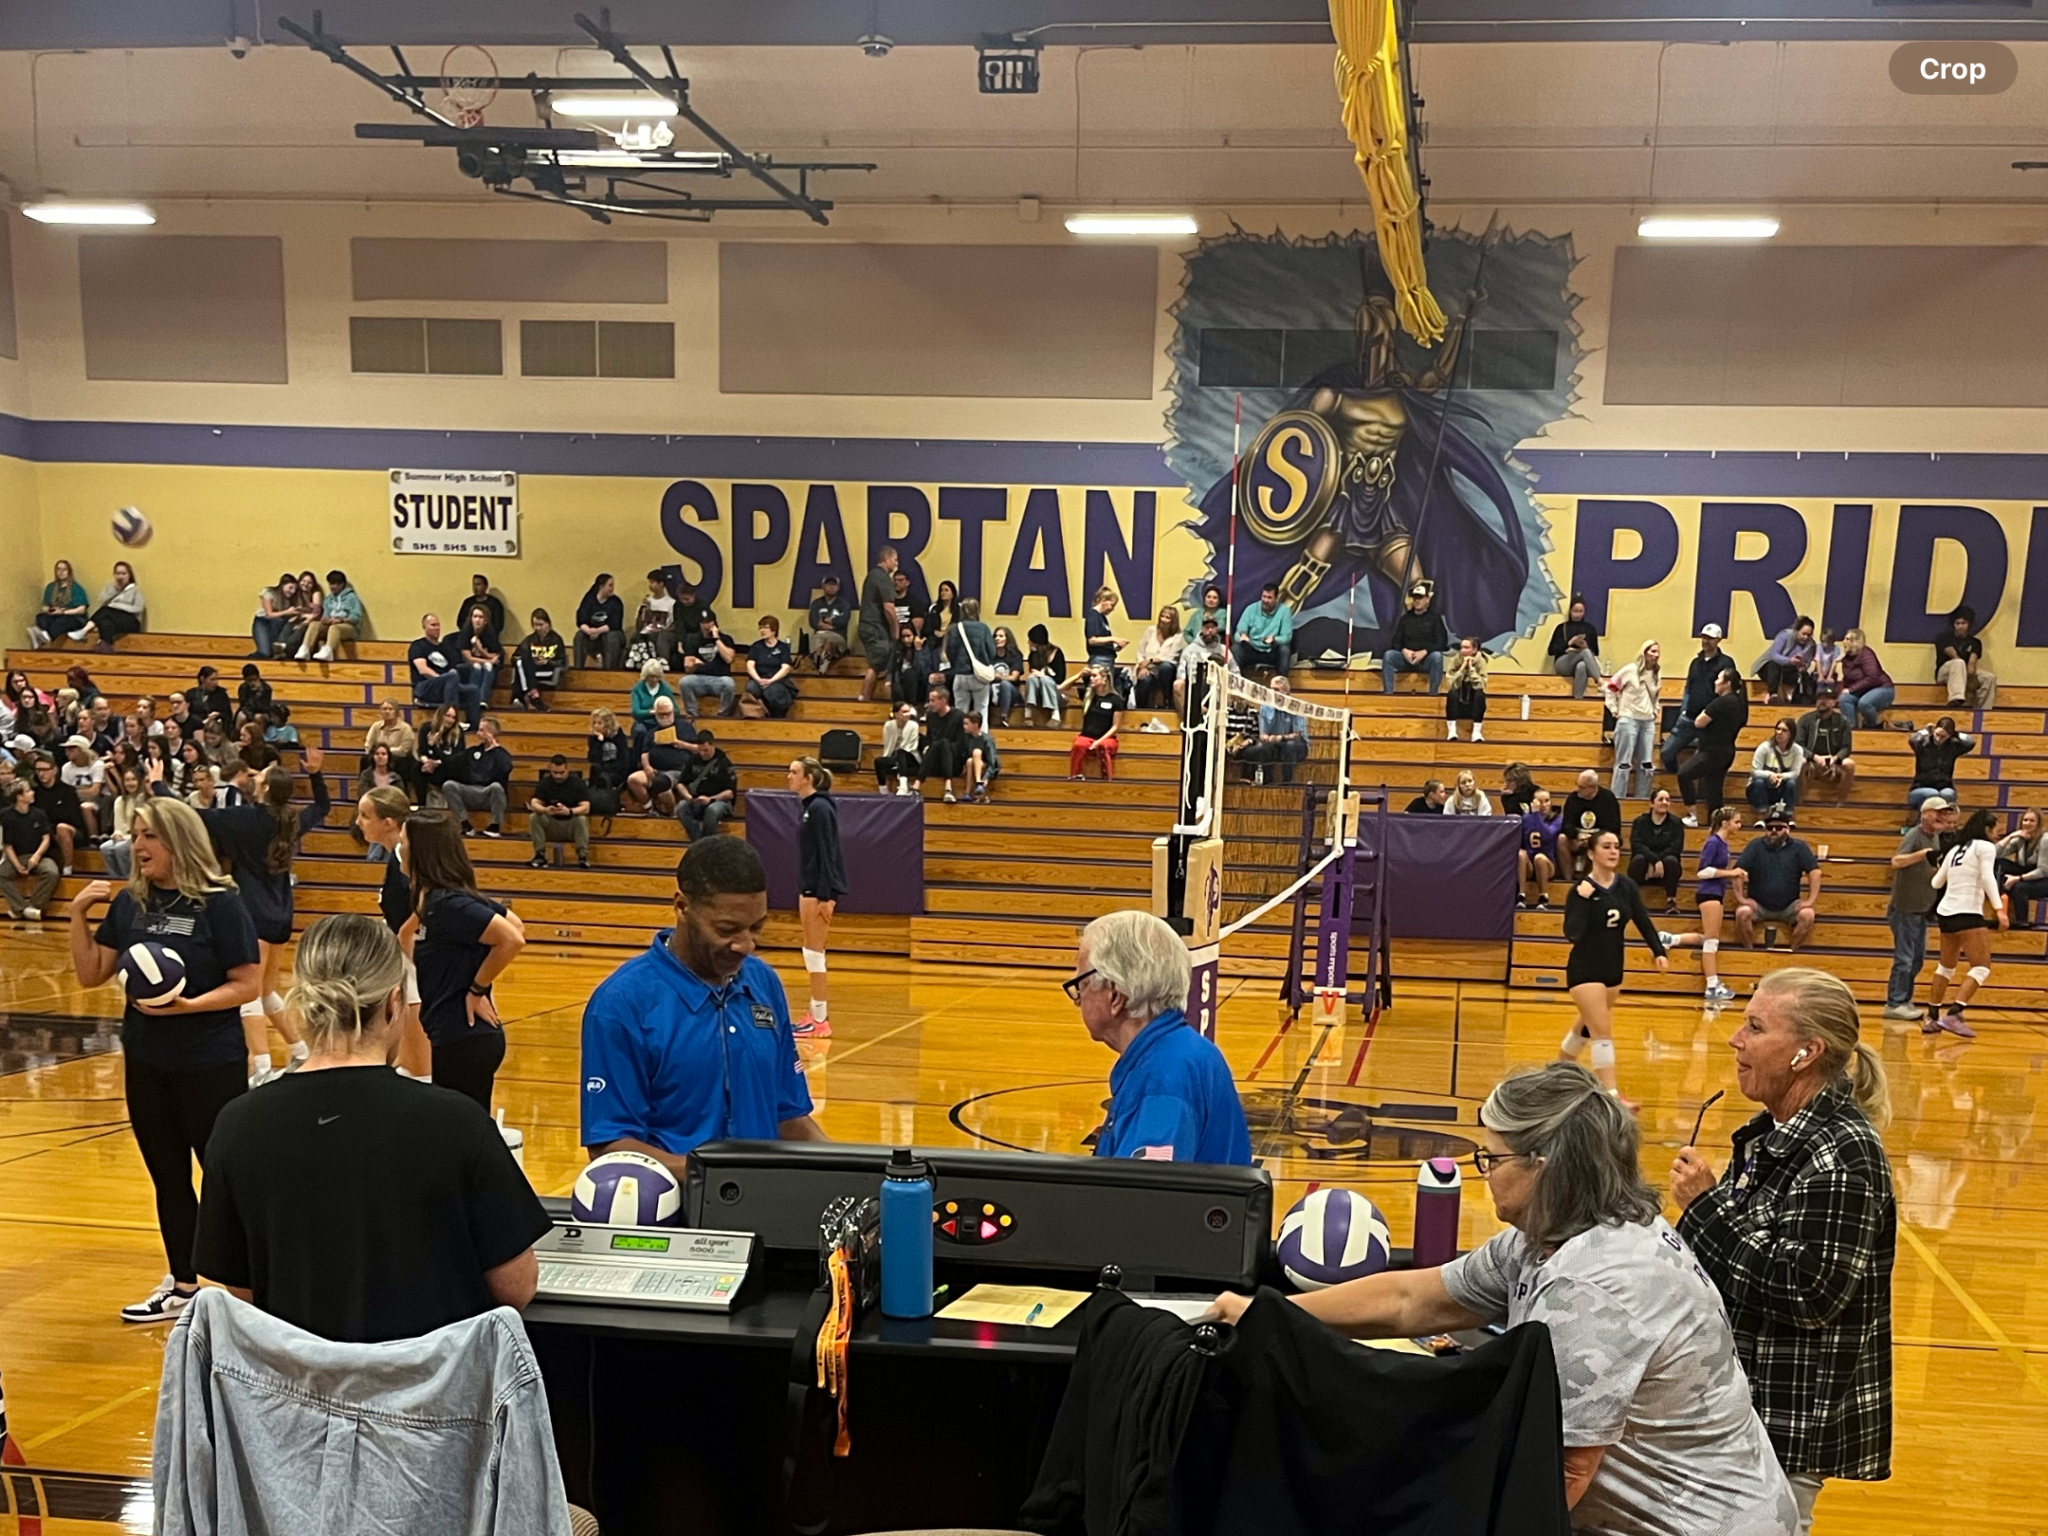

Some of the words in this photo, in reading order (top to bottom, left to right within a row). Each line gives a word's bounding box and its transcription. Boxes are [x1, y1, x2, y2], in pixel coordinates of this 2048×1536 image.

[404, 472, 441, 481] Sumner
[444, 473, 467, 483] High
[469, 474, 502, 482] School
[1258, 427, 1314, 522] S
[393, 493, 513, 531] STUDENT
[412, 542, 437, 551] SHS
[443, 543, 468, 552] SHS
[473, 544, 498, 553] SHS
[660, 480, 1157, 619] SPARTAN
[1529, 831, 1542, 849] 6
[1606, 909, 1620, 928] 2
